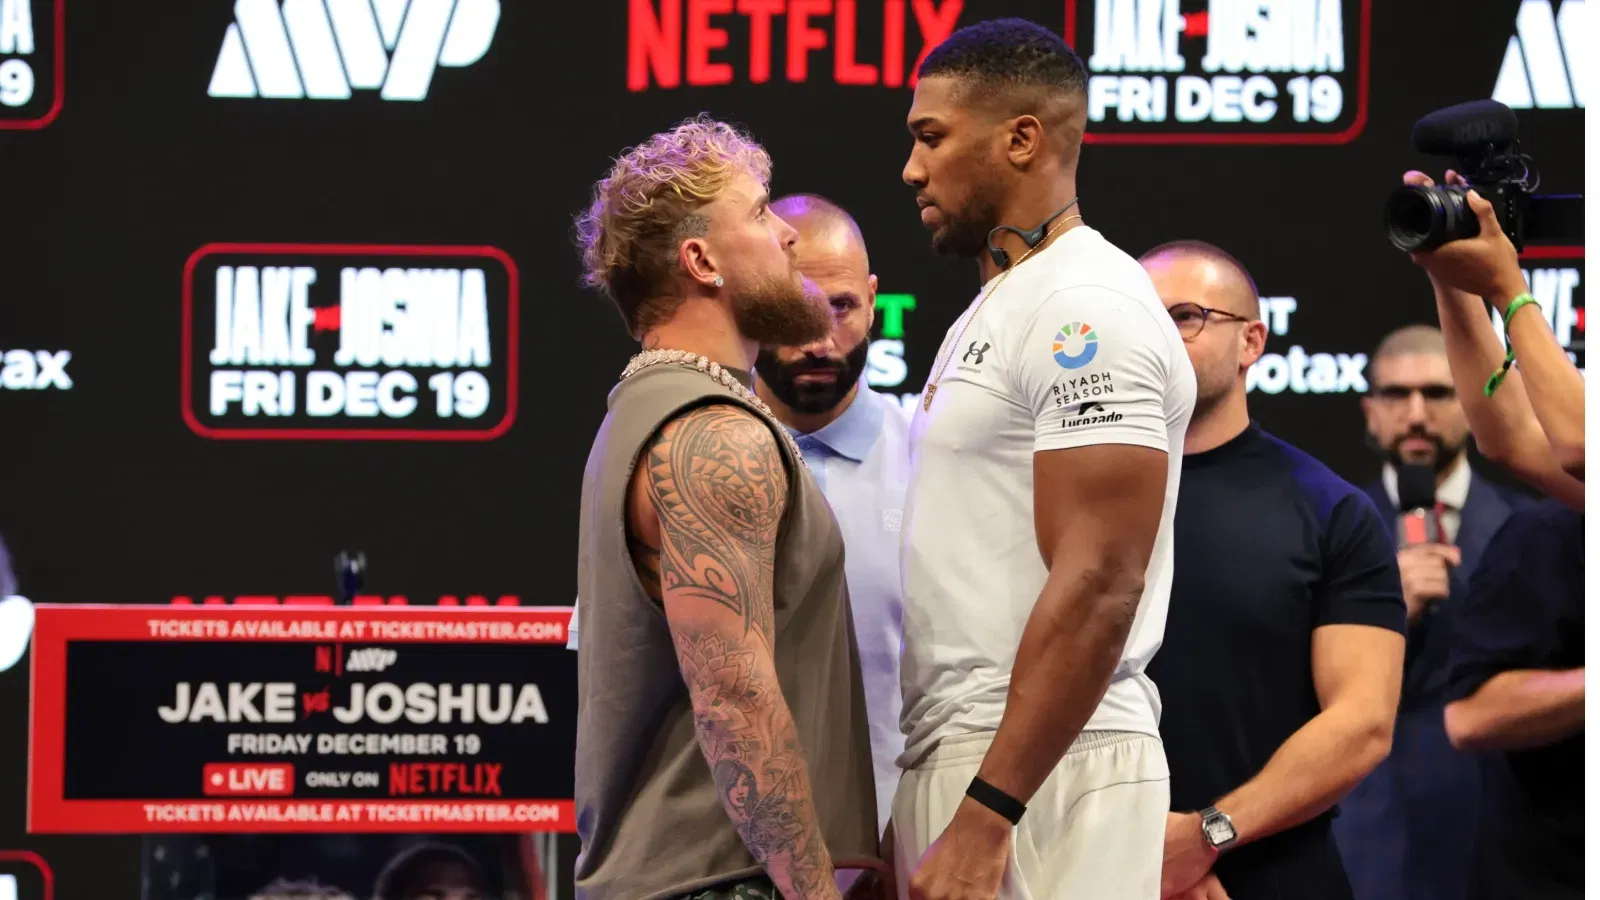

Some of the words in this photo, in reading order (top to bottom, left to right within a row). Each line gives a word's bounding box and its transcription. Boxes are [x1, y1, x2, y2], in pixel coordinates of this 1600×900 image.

[626, 0, 965, 92] NETFLIX
[1088, 0, 1185, 72] JAKE
[1202, 0, 1344, 73] JOSHUA
[1087, 75, 1168, 122] FRI
[1174, 75, 1278, 123] DEC
[1287, 75, 1343, 123] 19
[209, 266, 317, 366] JAKE
[334, 267, 491, 368] JOSHUA
[0, 349, 74, 390] ax
[1053, 371, 1112, 396] RIYADH
[210, 370, 296, 416] FRI
[306, 370, 418, 418] DEC
[428, 370, 490, 418] 19
[1056, 383, 1114, 408] SEASON
[148, 620, 229, 637] TICKETS
[231, 620, 337, 638] AVAILABLE
[340, 620, 367, 638] AT
[370, 620, 563, 639] TICKETMASTER.COM
[157, 682, 296, 723] JAKE
[332, 682, 549, 724] JOSHUA
[227, 733, 312, 754] FRIDAY
[317, 733, 448, 755] DECEMBER
[454, 733, 481, 755] 19
[228, 768, 285, 791] LIVE
[305, 771, 351, 788] ONLY
[352, 771, 380, 788] ON
[388, 762, 503, 796] NETFLIX
[144, 804, 226, 822] TICKETS
[228, 804, 334, 822] AVAILABLE
[336, 804, 362, 822] AT
[366, 804, 560, 822] TICKETMASTER.COM
